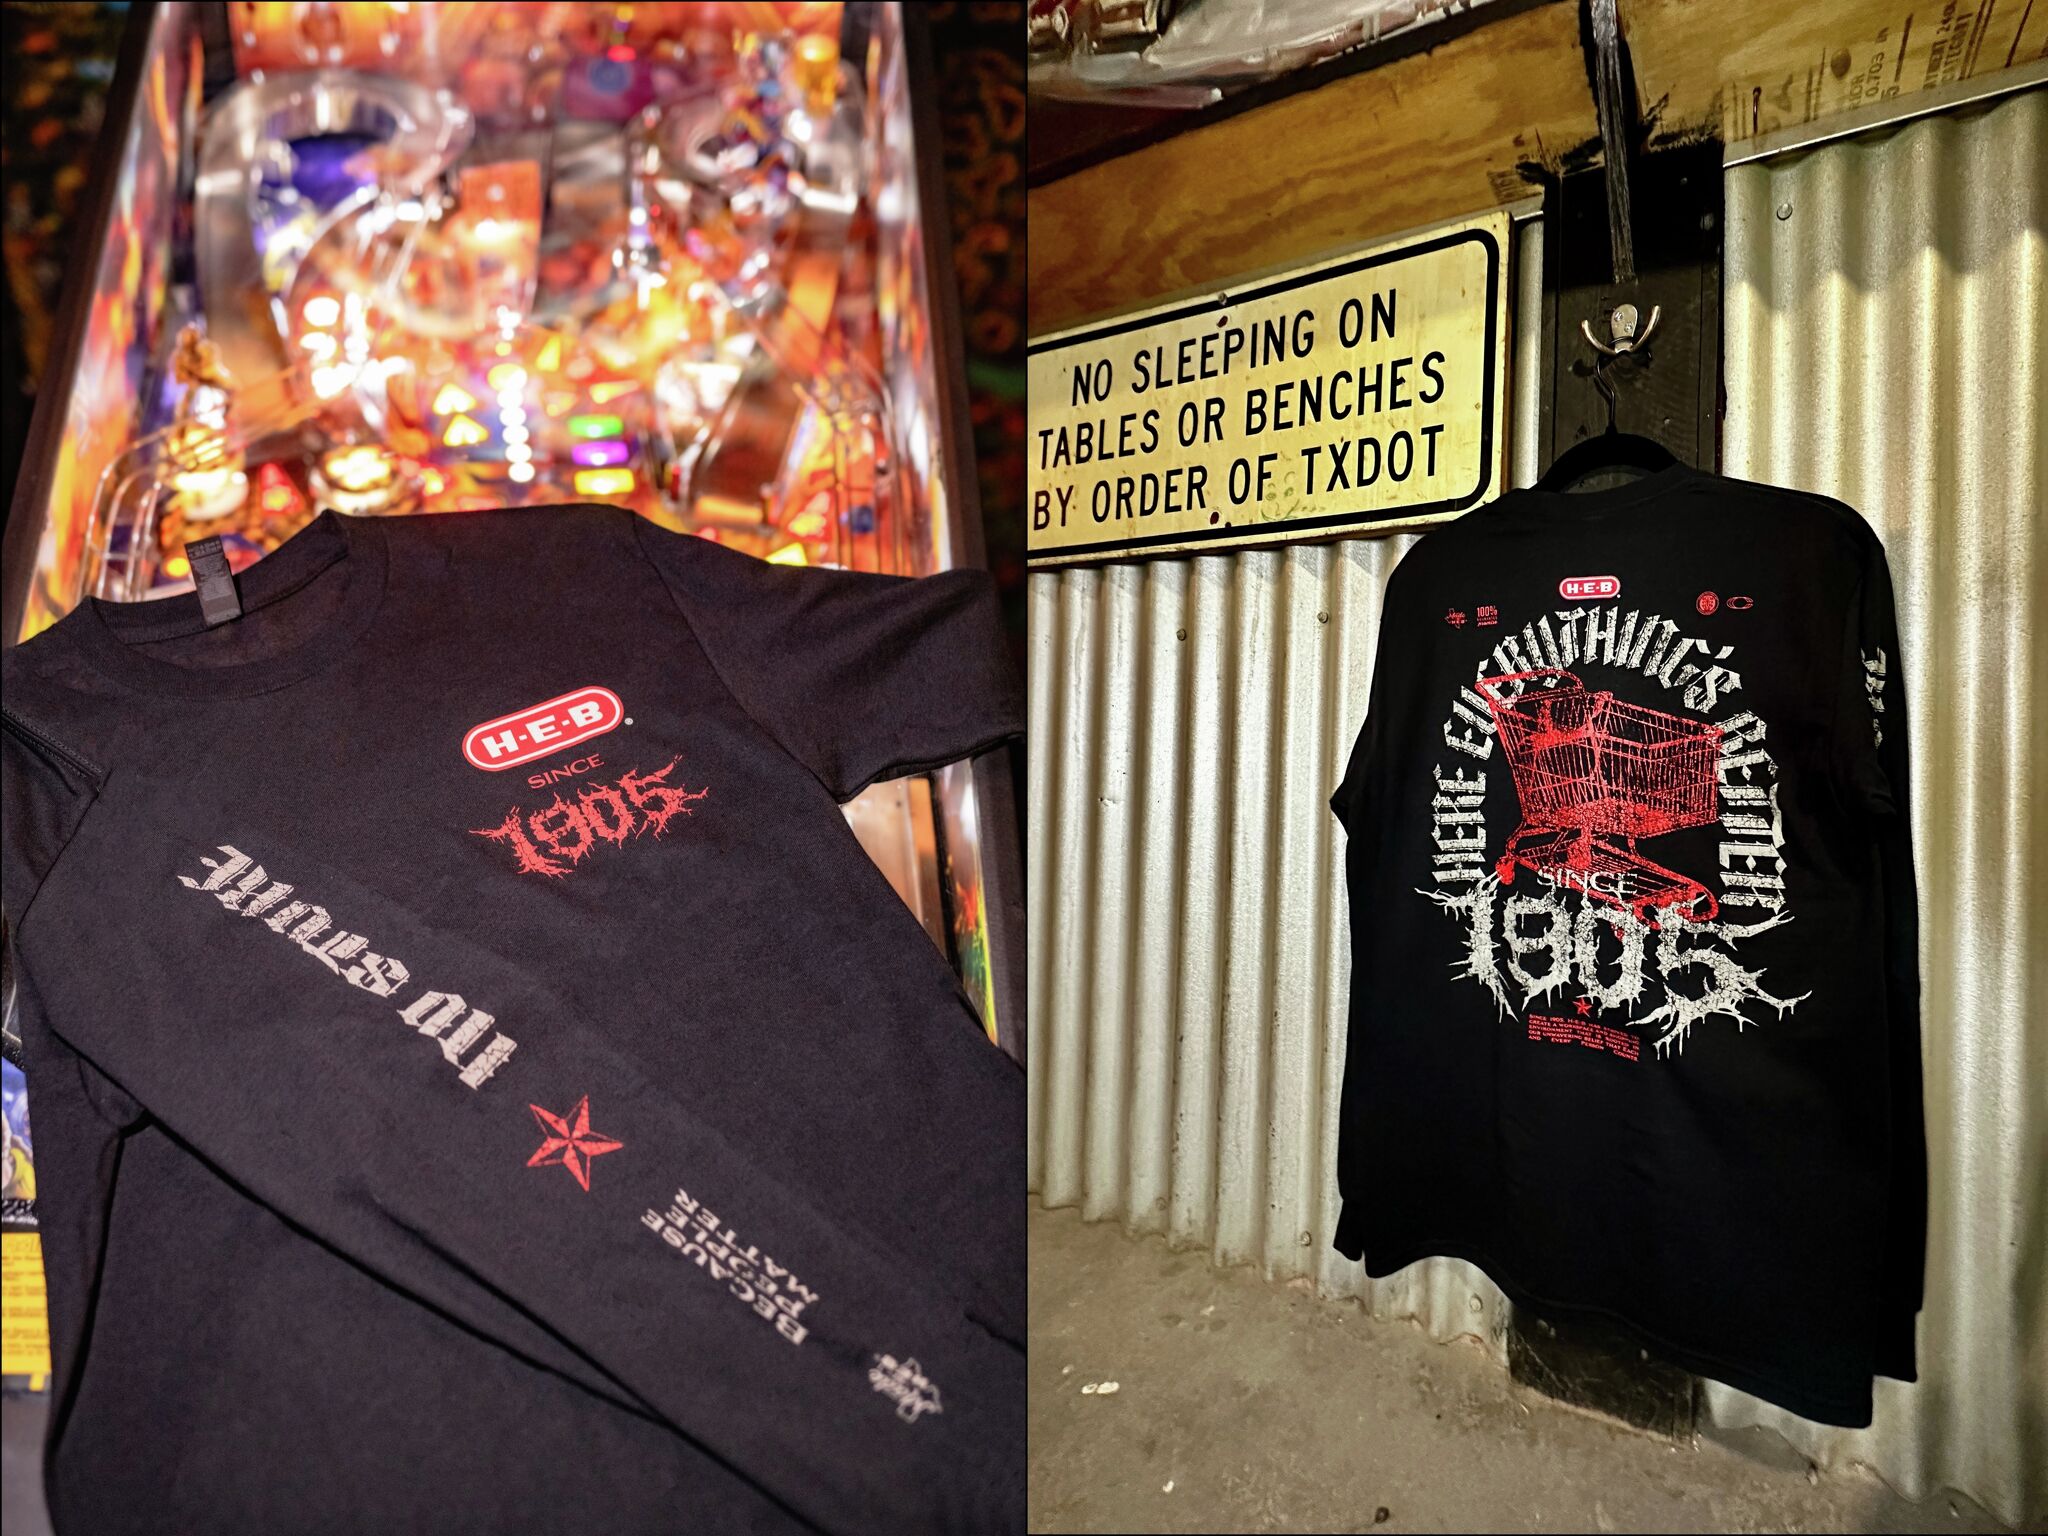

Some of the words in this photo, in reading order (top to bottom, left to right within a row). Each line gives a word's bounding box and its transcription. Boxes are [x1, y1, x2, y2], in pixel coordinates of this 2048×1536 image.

[1072, 359, 1112, 407] NO
[1131, 309, 1315, 394] SLEEPING
[1339, 288, 1396, 348] ON
[1038, 409, 1160, 470] TABLES
[1178, 396, 1225, 447] OR
[1245, 351, 1445, 437] BENCHES
[1033, 485, 1074, 531] BY
[1092, 465, 1209, 523] ORDER
[1229, 453, 1278, 505] OF
[1301, 424, 1445, 495] TXDOT
[1477, 605, 1498, 617] 100%
[1444, 606, 1743, 761] EVERYTHING'S
[468, 754, 710, 880] 1905
[527, 753, 605, 790] SINCE
[1431, 763, 1487, 882] HERE
[1717, 709, 1786, 915] BETTER
[177, 844, 410, 998] STORE
[1537, 866, 1638, 893] SINCE
[1414, 872, 1813, 1061] 1905
[396, 990, 518, 1091] NO
[1529, 1025, 1572, 1033] ENVIRONMENT
[1559, 1023, 1593, 1032] WORKSPACE
[1581, 1041, 1604, 1050] PERSON
[1623, 1047, 1639, 1055] EACH
[640, 1208, 809, 1345] BECAUSE
[665, 1204, 806, 1318] PEOPLE
[675, 1188, 819, 1304] MATTER
